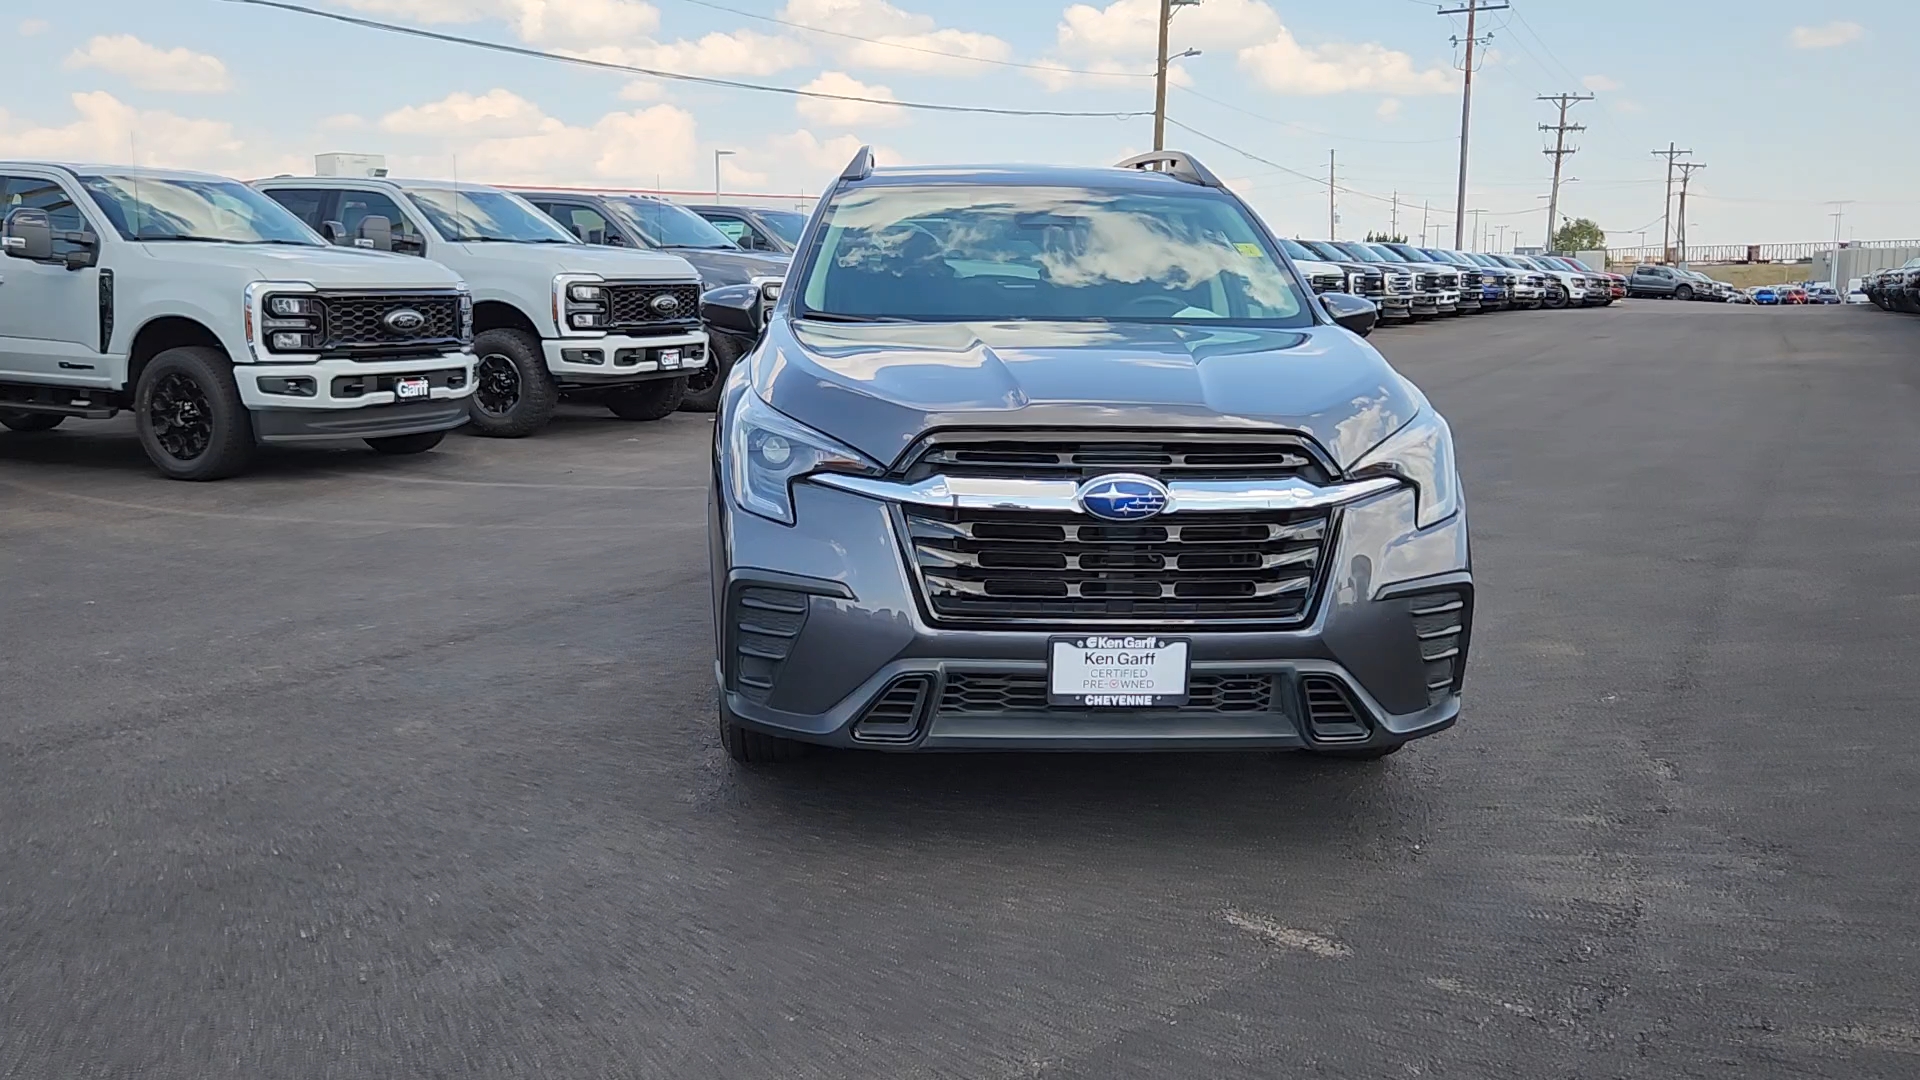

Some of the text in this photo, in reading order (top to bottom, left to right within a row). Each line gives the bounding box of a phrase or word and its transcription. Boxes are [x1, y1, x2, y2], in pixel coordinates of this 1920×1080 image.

[397, 380, 429, 398] Garff
[1098, 637, 1157, 649] Ken Garff
[1084, 652, 1156, 666] Ken Garff
[1090, 669, 1148, 678] CERTIFIED
[1084, 695, 1152, 706] CHEYENNE
